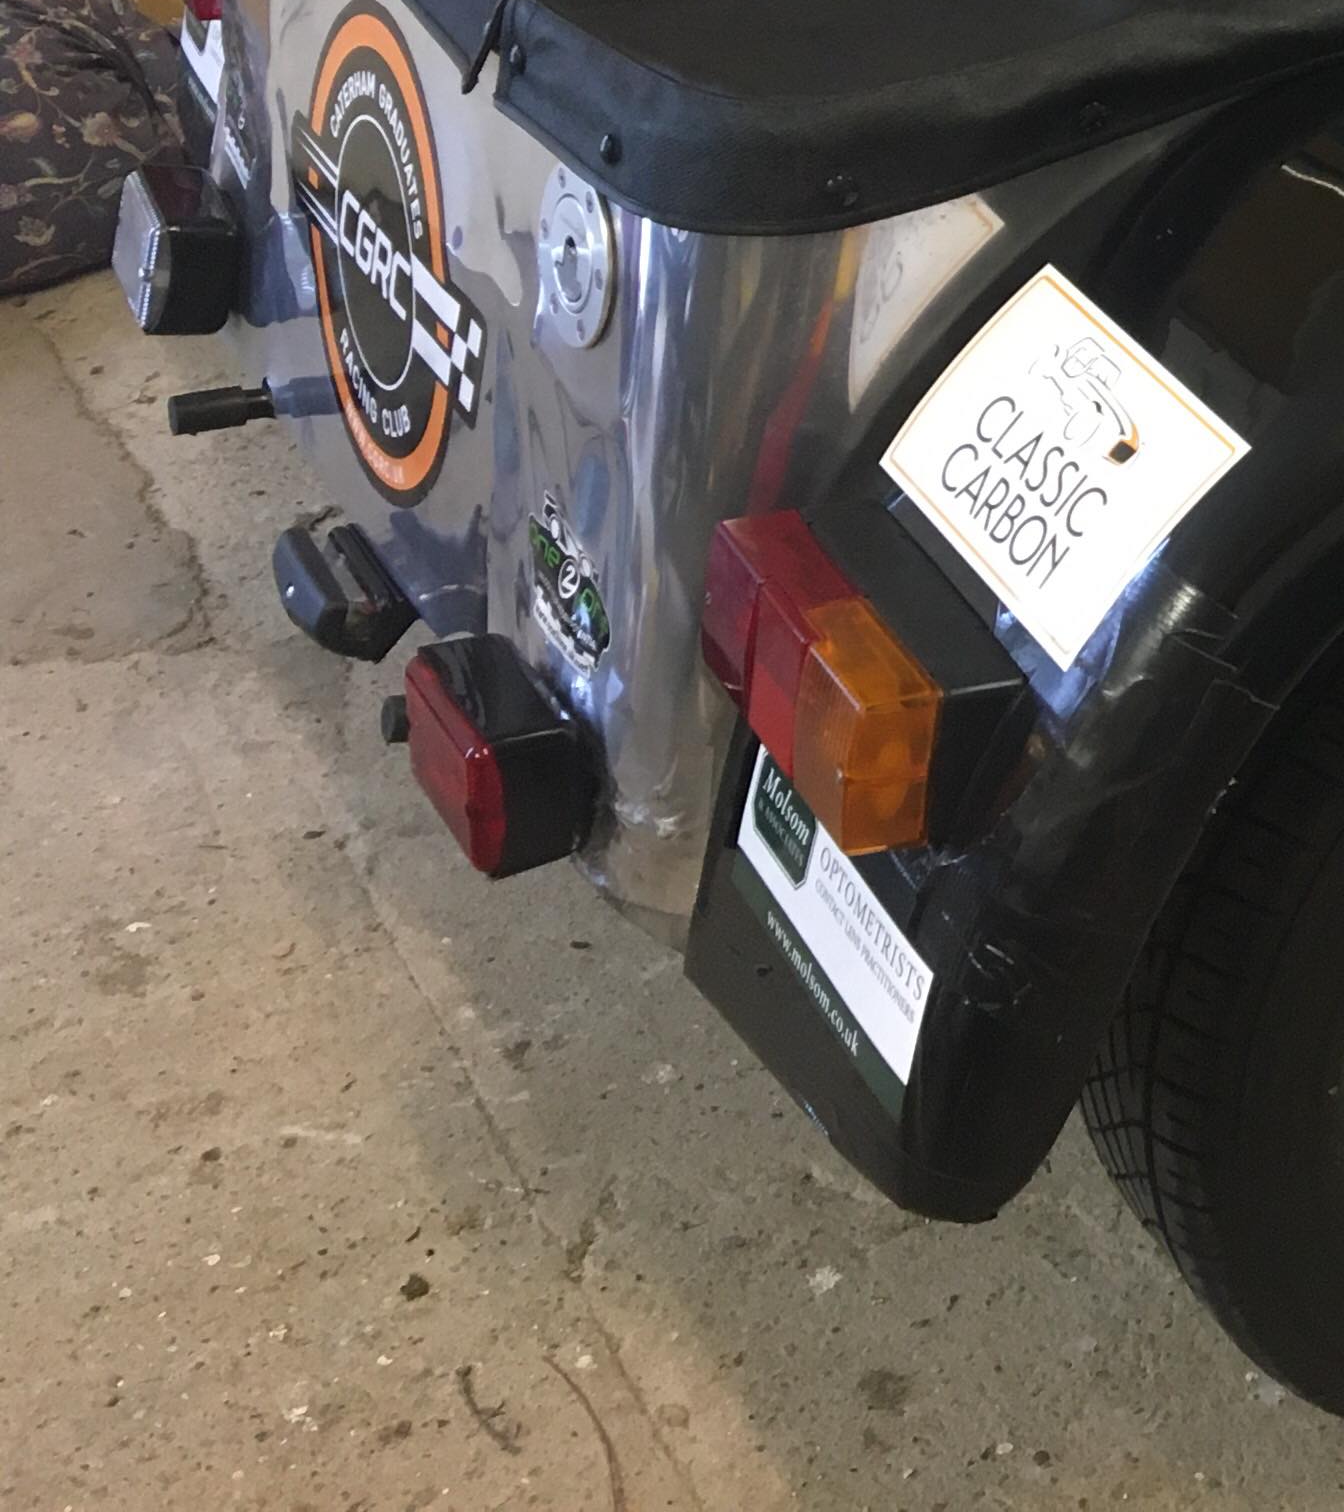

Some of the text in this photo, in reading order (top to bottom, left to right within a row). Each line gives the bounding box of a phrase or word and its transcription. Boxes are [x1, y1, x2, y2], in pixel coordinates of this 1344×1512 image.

[329, 70, 424, 240] CATERHAM GRADUATES
[339, 189, 412, 321] CGRC
[339, 327, 411, 438] RACING CLUB
[941, 443, 1070, 590] CARBON
[976, 395, 1108, 538] CLASSIC
[561, 564, 576, 588] 2
[762, 768, 810, 846] Molsom
[767, 909, 860, 1057] www.molsom.co.uk
[820, 847, 926, 1002] OPTOMETRISTS
